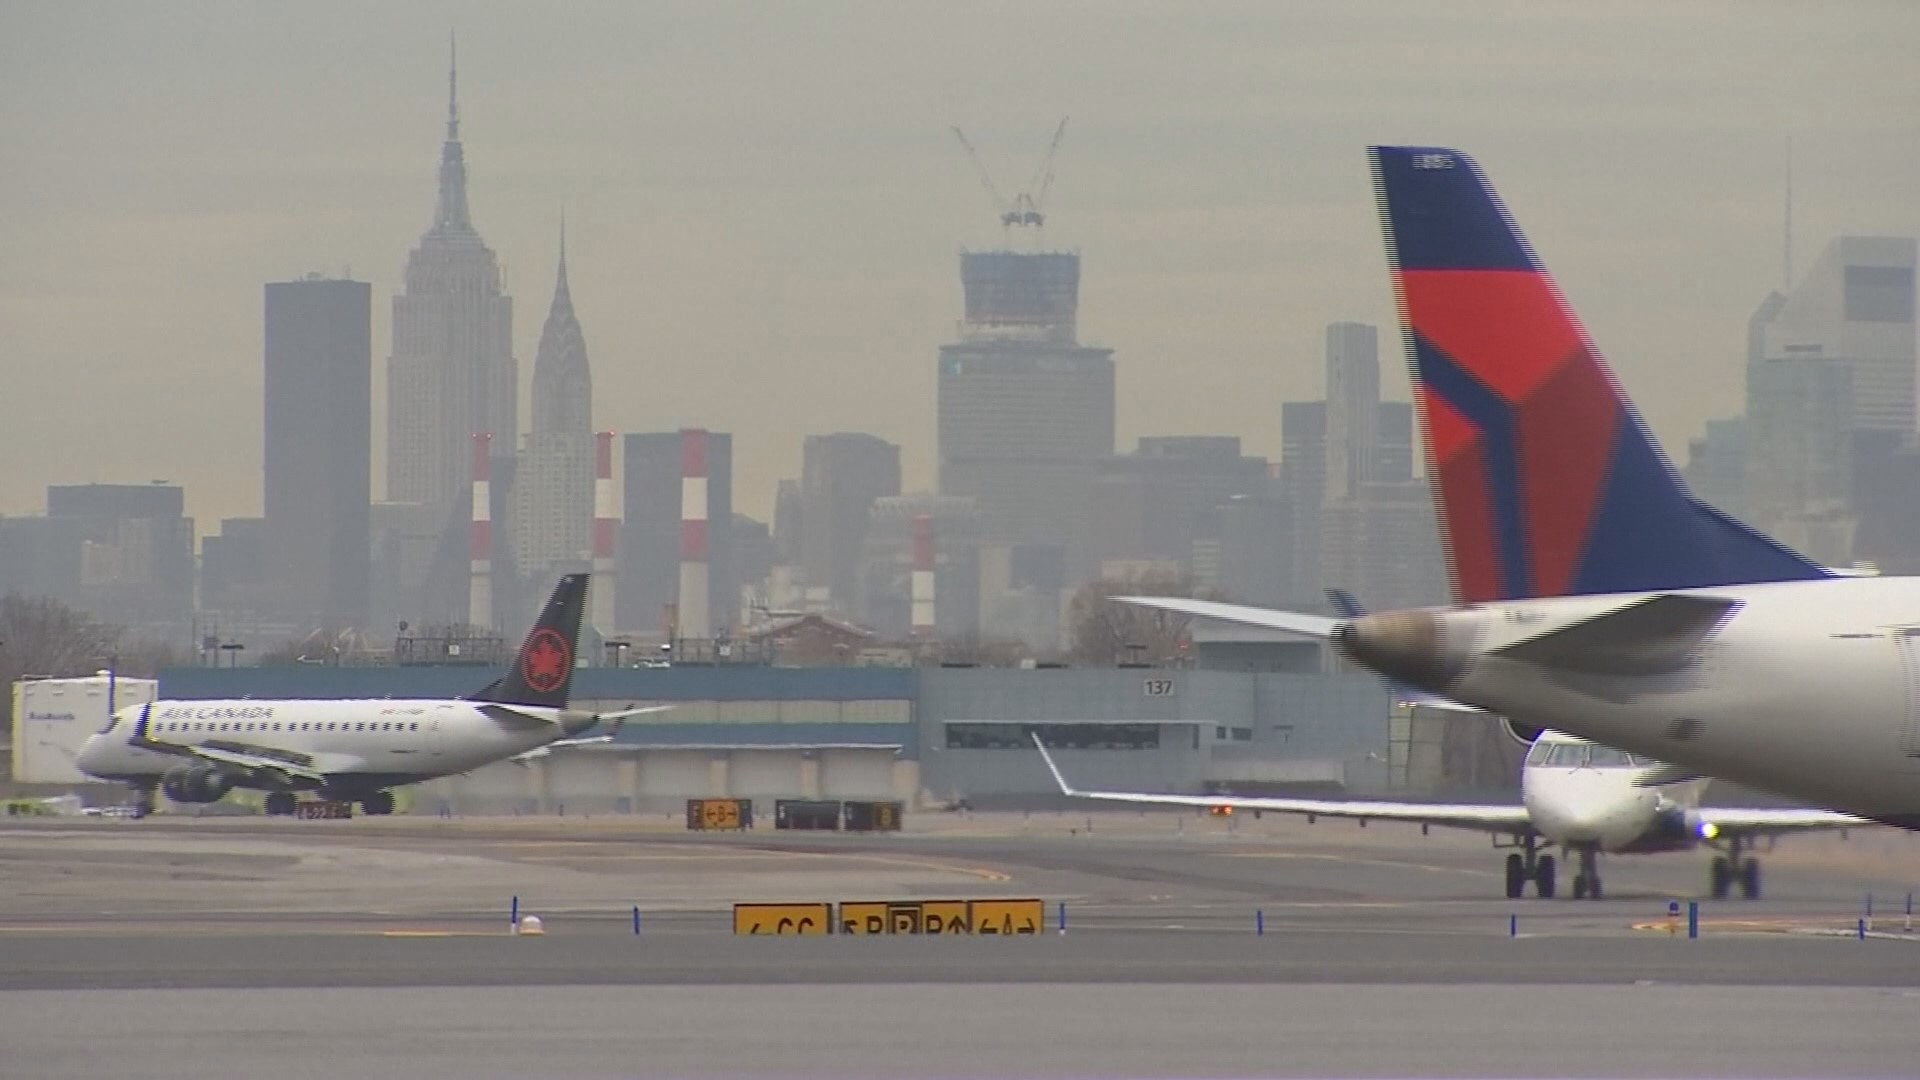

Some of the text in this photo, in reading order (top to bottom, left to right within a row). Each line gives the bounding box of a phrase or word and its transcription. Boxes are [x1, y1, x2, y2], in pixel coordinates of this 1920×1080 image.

[1146, 680, 1172, 695] 137
[158, 706, 275, 720] AIR CANADA
